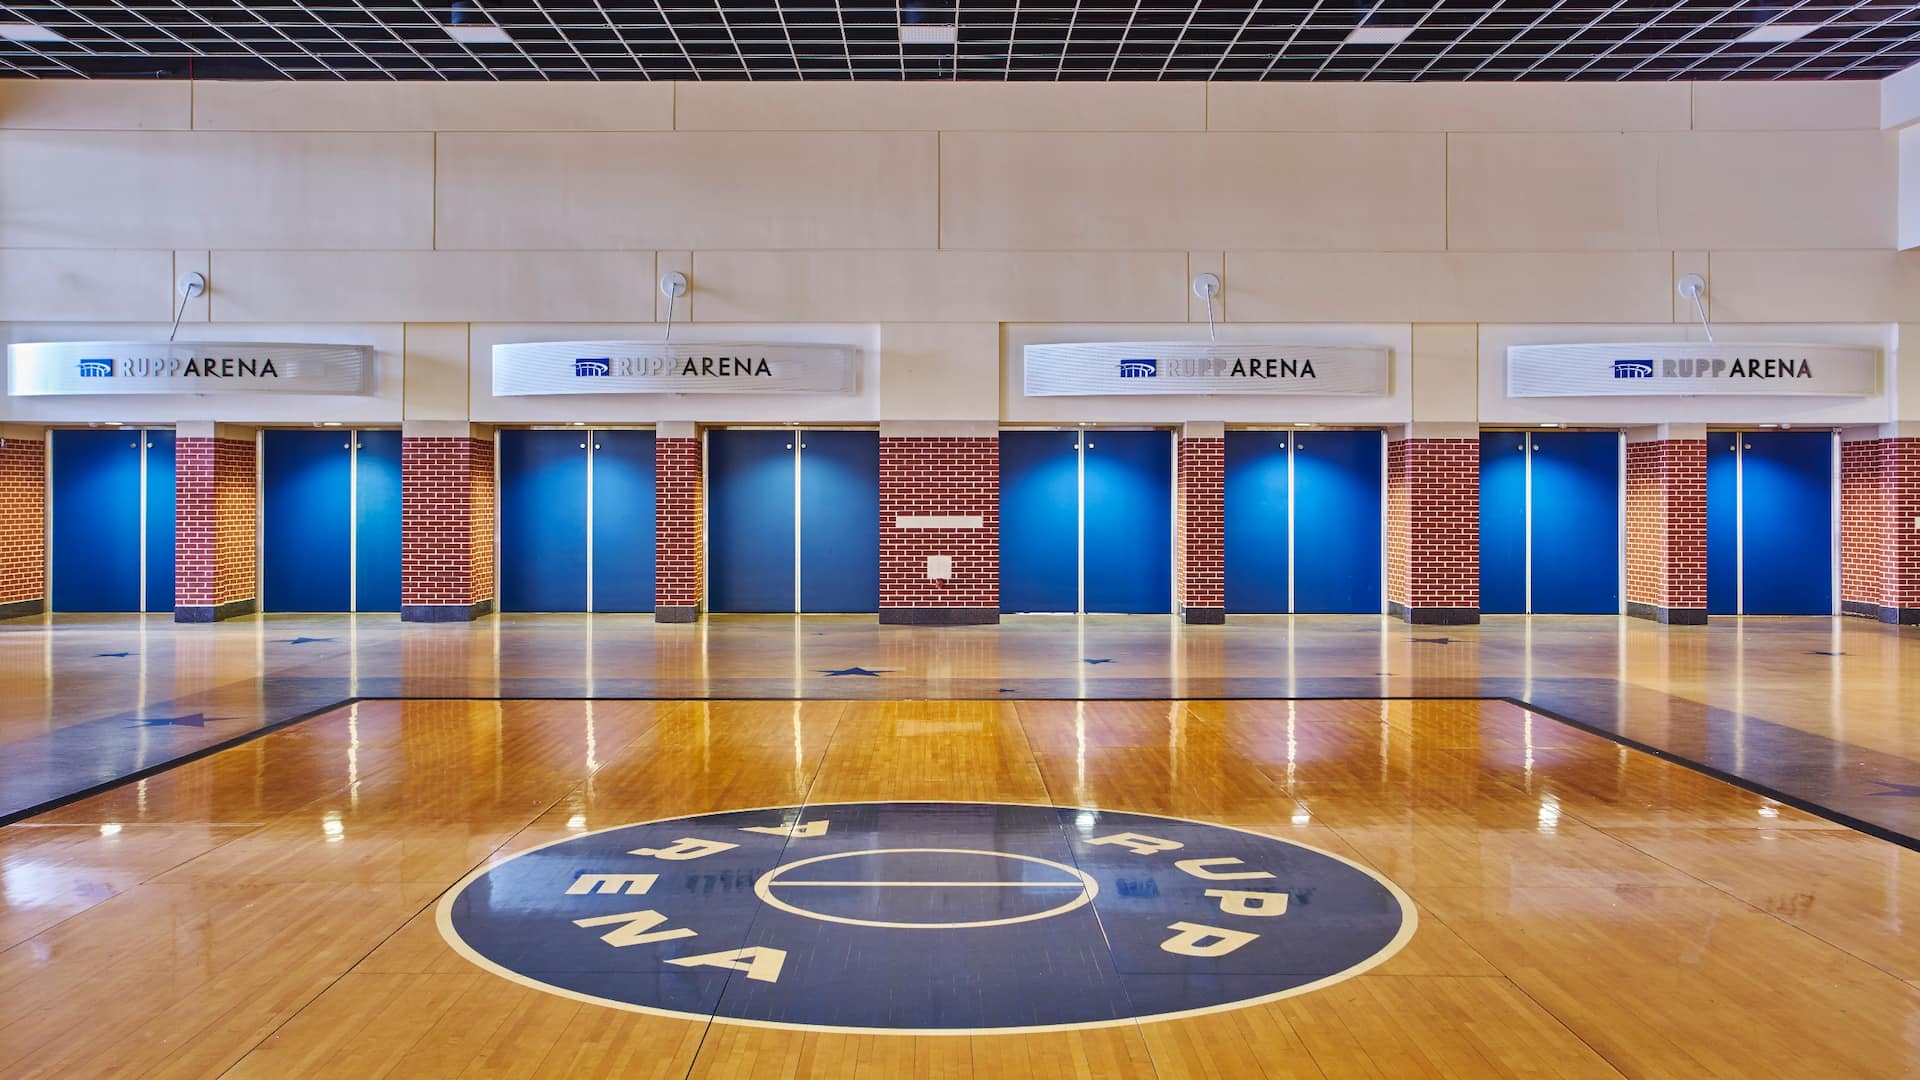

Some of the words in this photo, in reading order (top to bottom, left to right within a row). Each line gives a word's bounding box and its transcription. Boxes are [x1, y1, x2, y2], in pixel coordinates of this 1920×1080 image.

[184, 358, 279, 378] ARENA
[681, 357, 772, 377] ARENA
[1230, 358, 1316, 379] ARENA
[1730, 358, 1812, 379] ARENA
[565, 820, 830, 983] ARENA
[1088, 832, 1289, 957] RUPP
